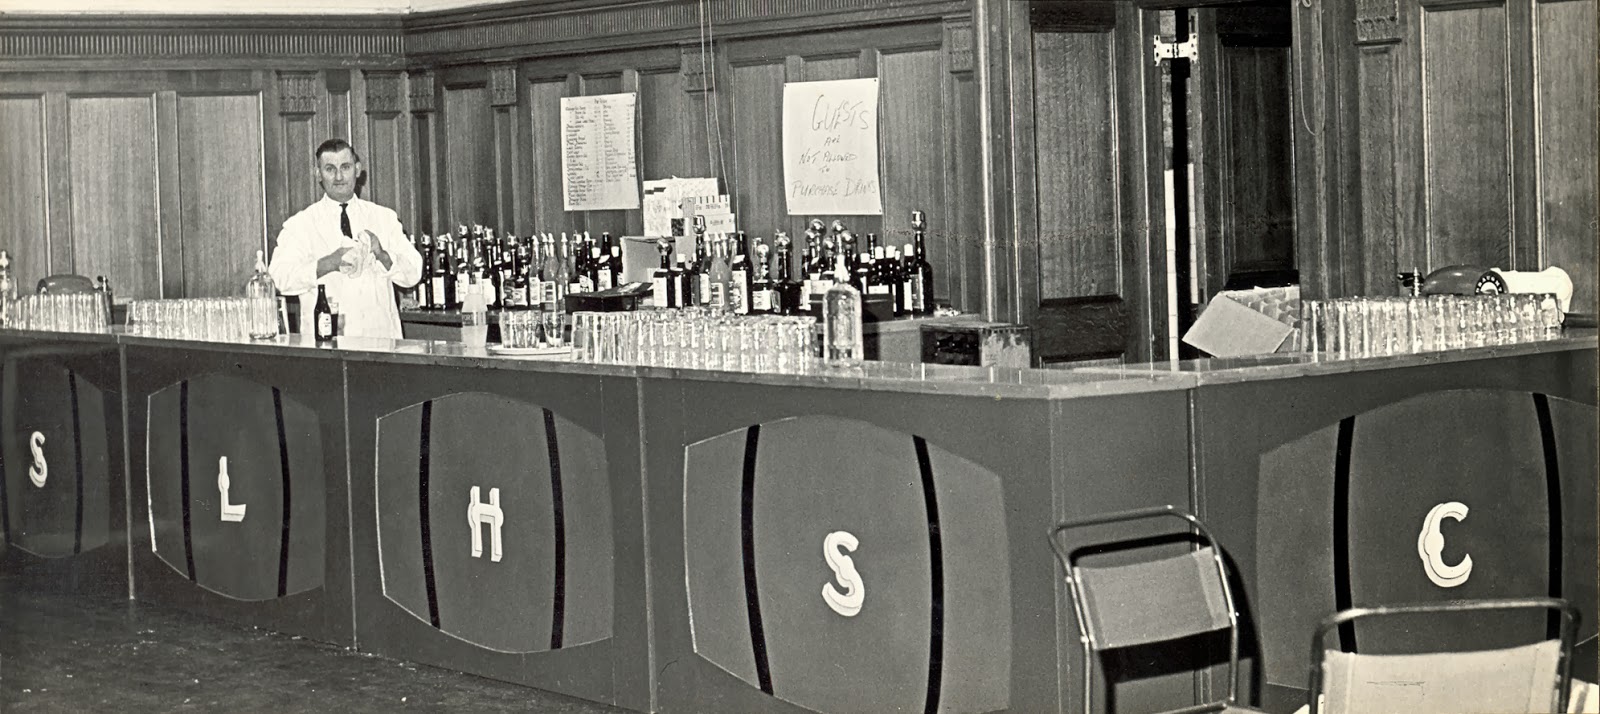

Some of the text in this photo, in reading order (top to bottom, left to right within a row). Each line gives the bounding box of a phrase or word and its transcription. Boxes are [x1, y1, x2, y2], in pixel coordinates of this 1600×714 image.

[812, 94, 868, 131] GUESTS
[29, 431, 48, 488] S
[217, 456, 247, 522] L
[467, 485, 504, 563] H
[1417, 501, 1473, 588] C
[821, 530, 865, 617] S
